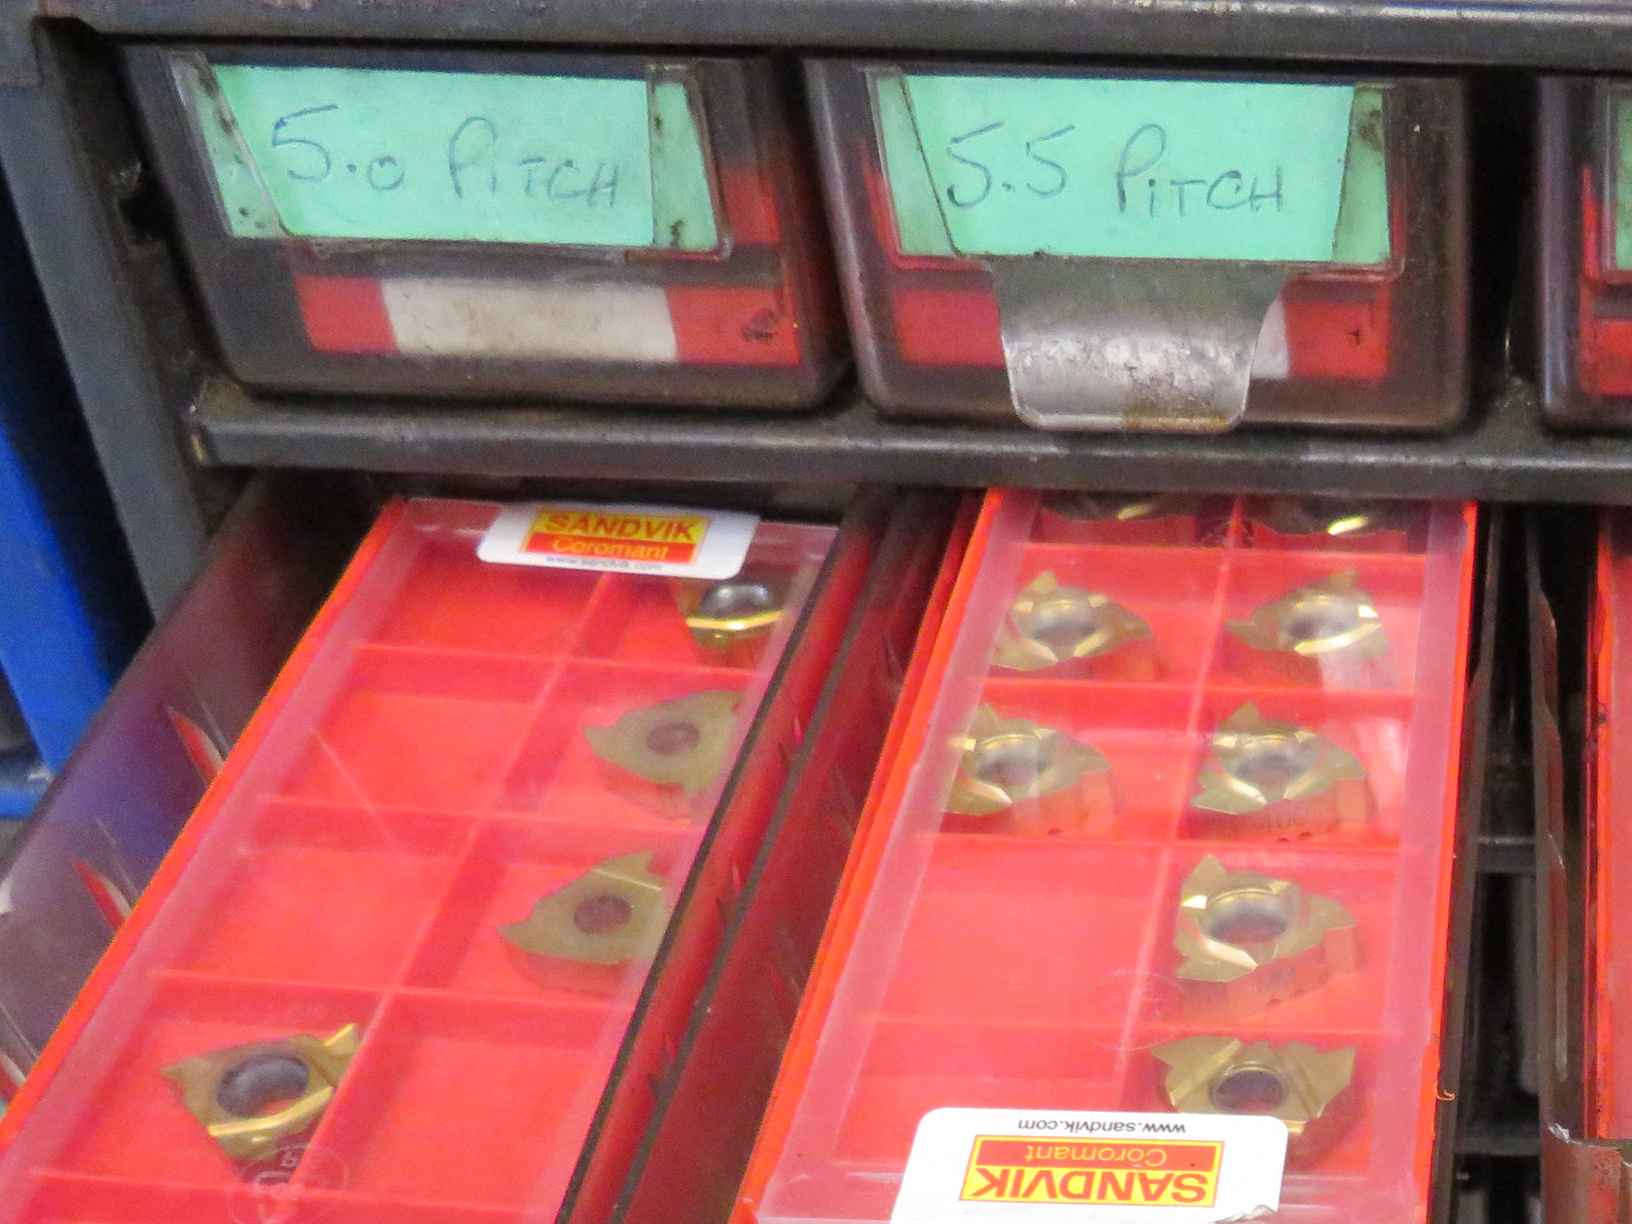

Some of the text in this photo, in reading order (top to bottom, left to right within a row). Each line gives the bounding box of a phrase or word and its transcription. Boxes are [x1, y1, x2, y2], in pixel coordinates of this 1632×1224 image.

[270, 104, 407, 192] 5.0
[945, 120, 1076, 211] 5.5
[546, 512, 697, 541] SANDVIK
[552, 536, 669, 561] Coromant
[1016, 1118, 1187, 1136] www.sandvik.com
[1026, 1142, 1168, 1166] Coromant
[972, 1166, 1210, 1204] SANDVIK
